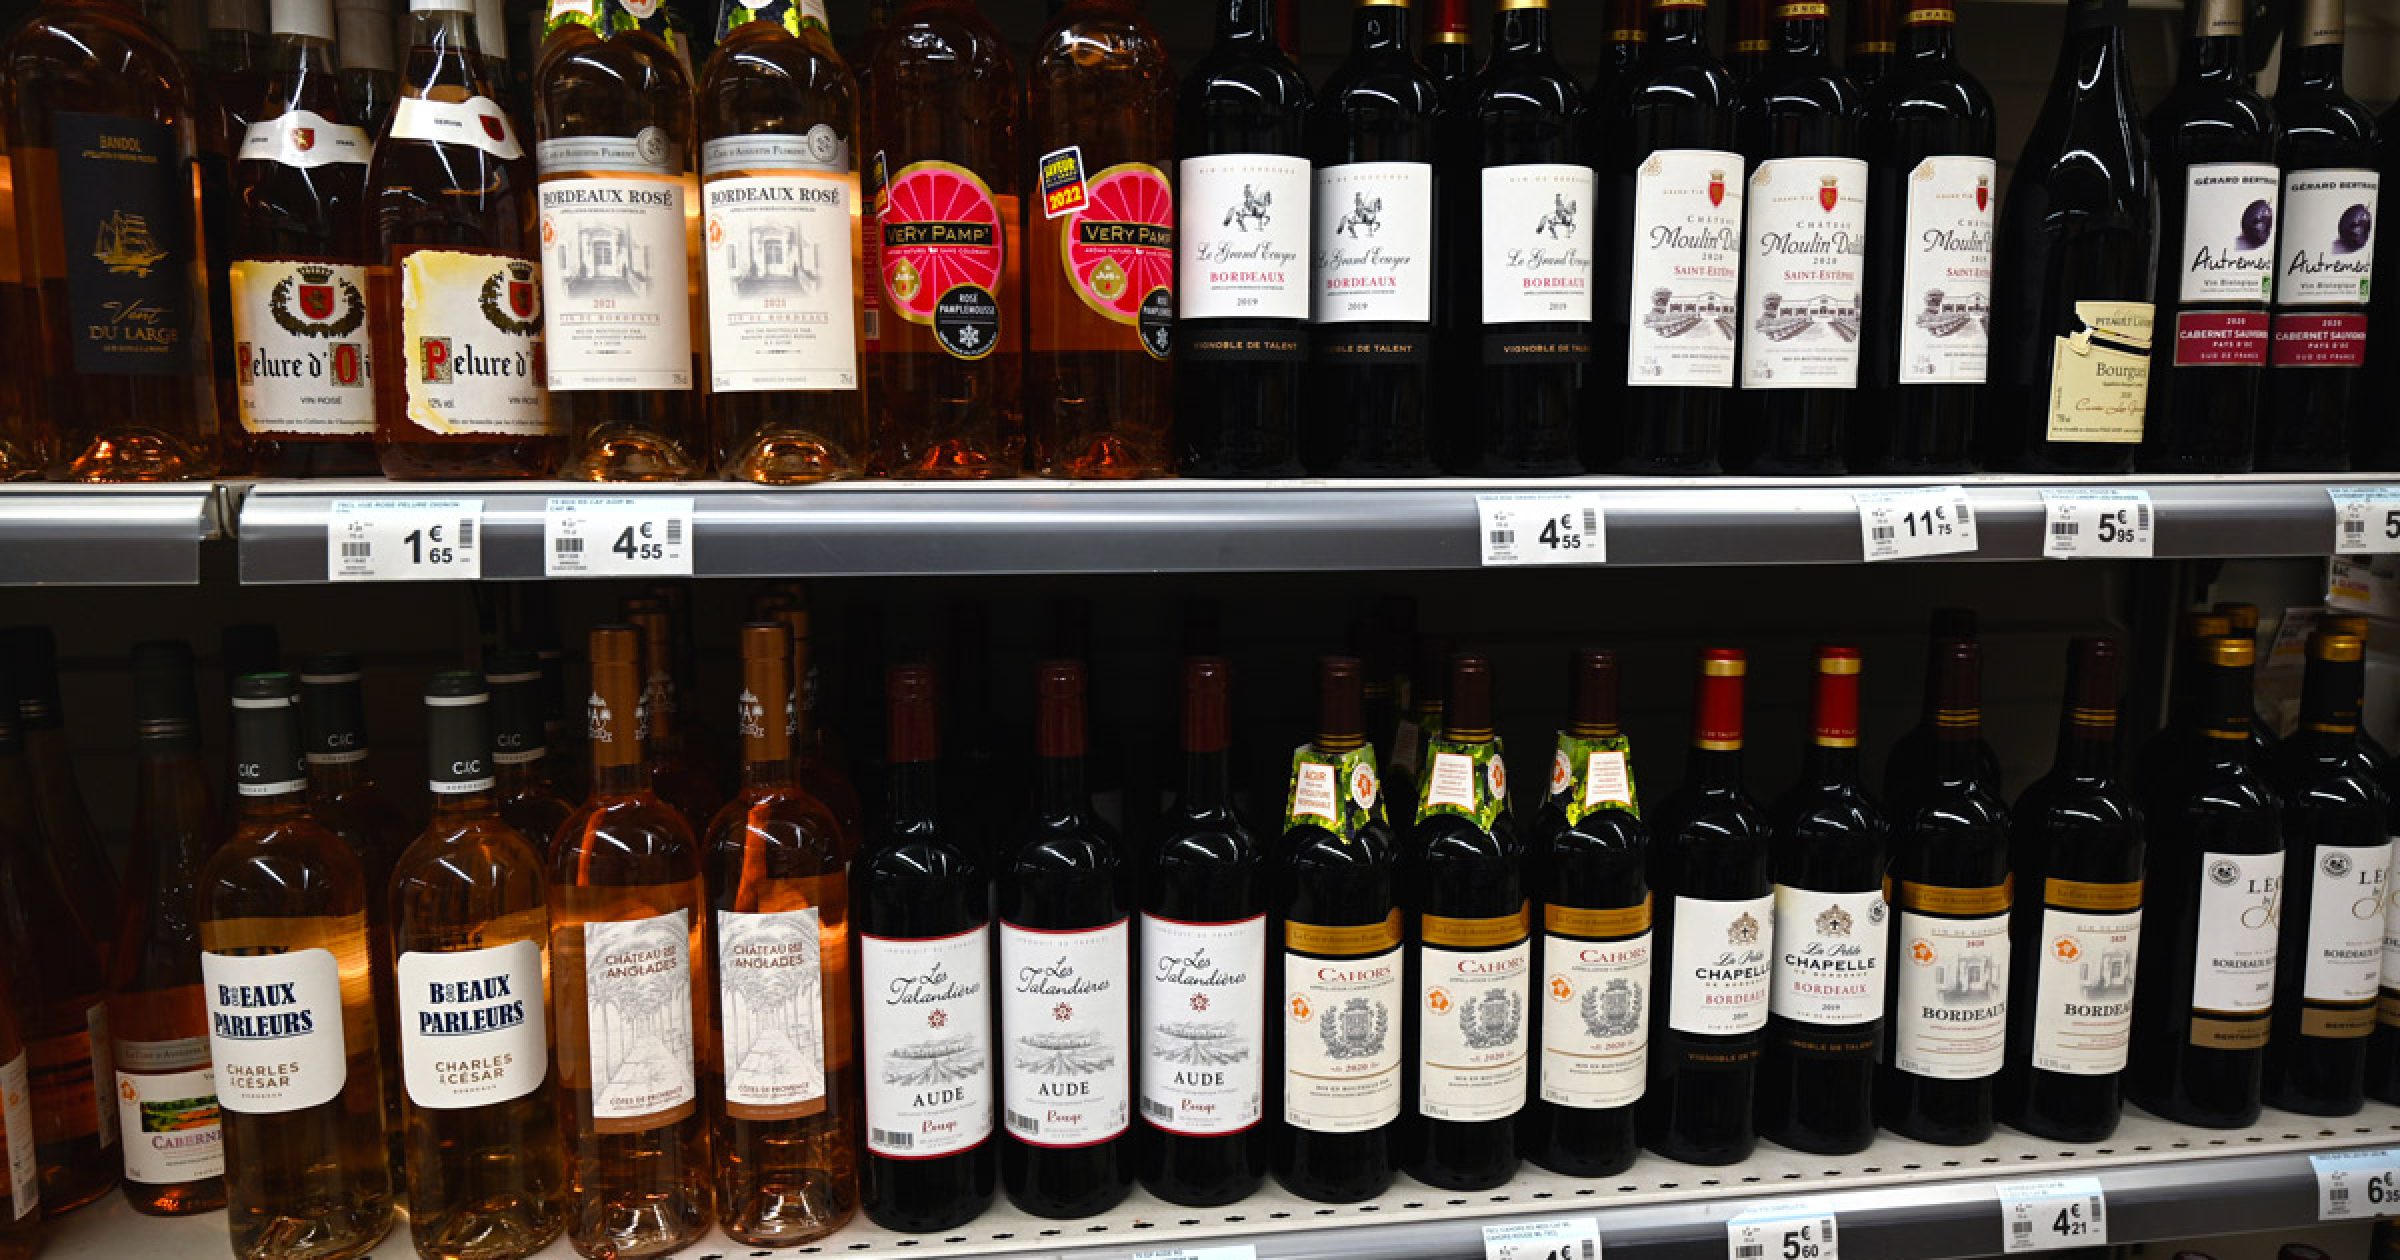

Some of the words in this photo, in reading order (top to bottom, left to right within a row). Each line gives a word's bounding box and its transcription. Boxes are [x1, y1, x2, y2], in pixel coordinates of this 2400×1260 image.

[2193, 174, 2240, 187] GÉRARD
[2290, 180, 2337, 193] GÉRARD
[543, 188, 623, 208] BORDEAUX
[628, 188, 673, 208] ROSÉ
[711, 187, 793, 206] BORDEAUX
[799, 186, 841, 206] ROSÉ
[1049, 187, 1083, 211] 2022
[1085, 225, 1135, 242] VERY
[1650, 225, 1717, 250] Moulin
[1922, 229, 1983, 252] Moulin
[1760, 231, 1831, 256] Moulin
[1209, 271, 1285, 283] BORDEAUX
[1327, 276, 1397, 289] BORDEAUX
[1236, 297, 1259, 307] 2019
[1347, 302, 1369, 311] 2019
[1549, 302, 1568, 311] 2019
[88, 325, 118, 341] DU
[2179, 329, 2233, 339] CABERNET
[2275, 331, 2329, 341] CABERNET
[1246, 341, 1261, 349] DE
[1263, 341, 1297, 350] TALENT
[1357, 344, 1371, 353] DE
[1373, 344, 1413, 353] TALENT
[1503, 344, 1556, 353] VIGNOBLE
[239, 343, 303, 384] Pelure
[423, 339, 511, 382] Pelure
[1903, 509, 1933, 537] 11
[1935, 505, 1947, 520] €
[1937, 523, 1953, 535] 75
[2098, 513, 2117, 542] 5
[2117, 509, 2128, 524] €
[1538, 517, 1561, 549] 4
[1560, 513, 1573, 530] €
[2116, 529, 2135, 543] 95
[404, 529, 422, 564] 1
[429, 525, 443, 543] €
[612, 526, 639, 559] 4
[640, 521, 653, 538] €
[1562, 533, 1581, 549] 55
[429, 548, 453, 564] 65
[640, 543, 663, 559] 55
[605, 948, 661, 965] CHÂTEAU
[733, 943, 788, 955] CHÂTEAU
[1579, 946, 1648, 963] CAHORS
[734, 956, 805, 969] ANGLADES
[1045, 955, 1075, 979] Les
[1183, 947, 1211, 970] Les
[1456, 955, 1526, 974] CAHORS
[1785, 953, 1877, 972] CHAPELLE
[606, 958, 677, 979] ANGLADES
[919, 961, 948, 986] Les
[1317, 963, 1392, 982] CAHORS
[1793, 981, 1867, 996] BORDEAUX
[213, 1009, 314, 1038] PARLEURS
[419, 999, 526, 1037] PARLEURS
[225, 1061, 301, 1075] CHARLES
[435, 1053, 513, 1073] CHARLES
[1173, 1071, 1225, 1087] AUDE
[912, 1084, 965, 1108] AUDE
[1038, 1081, 1091, 1097] AUDE
[2367, 1175, 2384, 1204] 6
[2052, 1207, 2071, 1236] 4
[2070, 1203, 2081, 1218] €
[2071, 1221, 2087, 1235] 21
[1782, 1231, 1801, 1260] 5
[1801, 1225, 1811, 1241] €
[1801, 1243, 1819, 1258] 60
